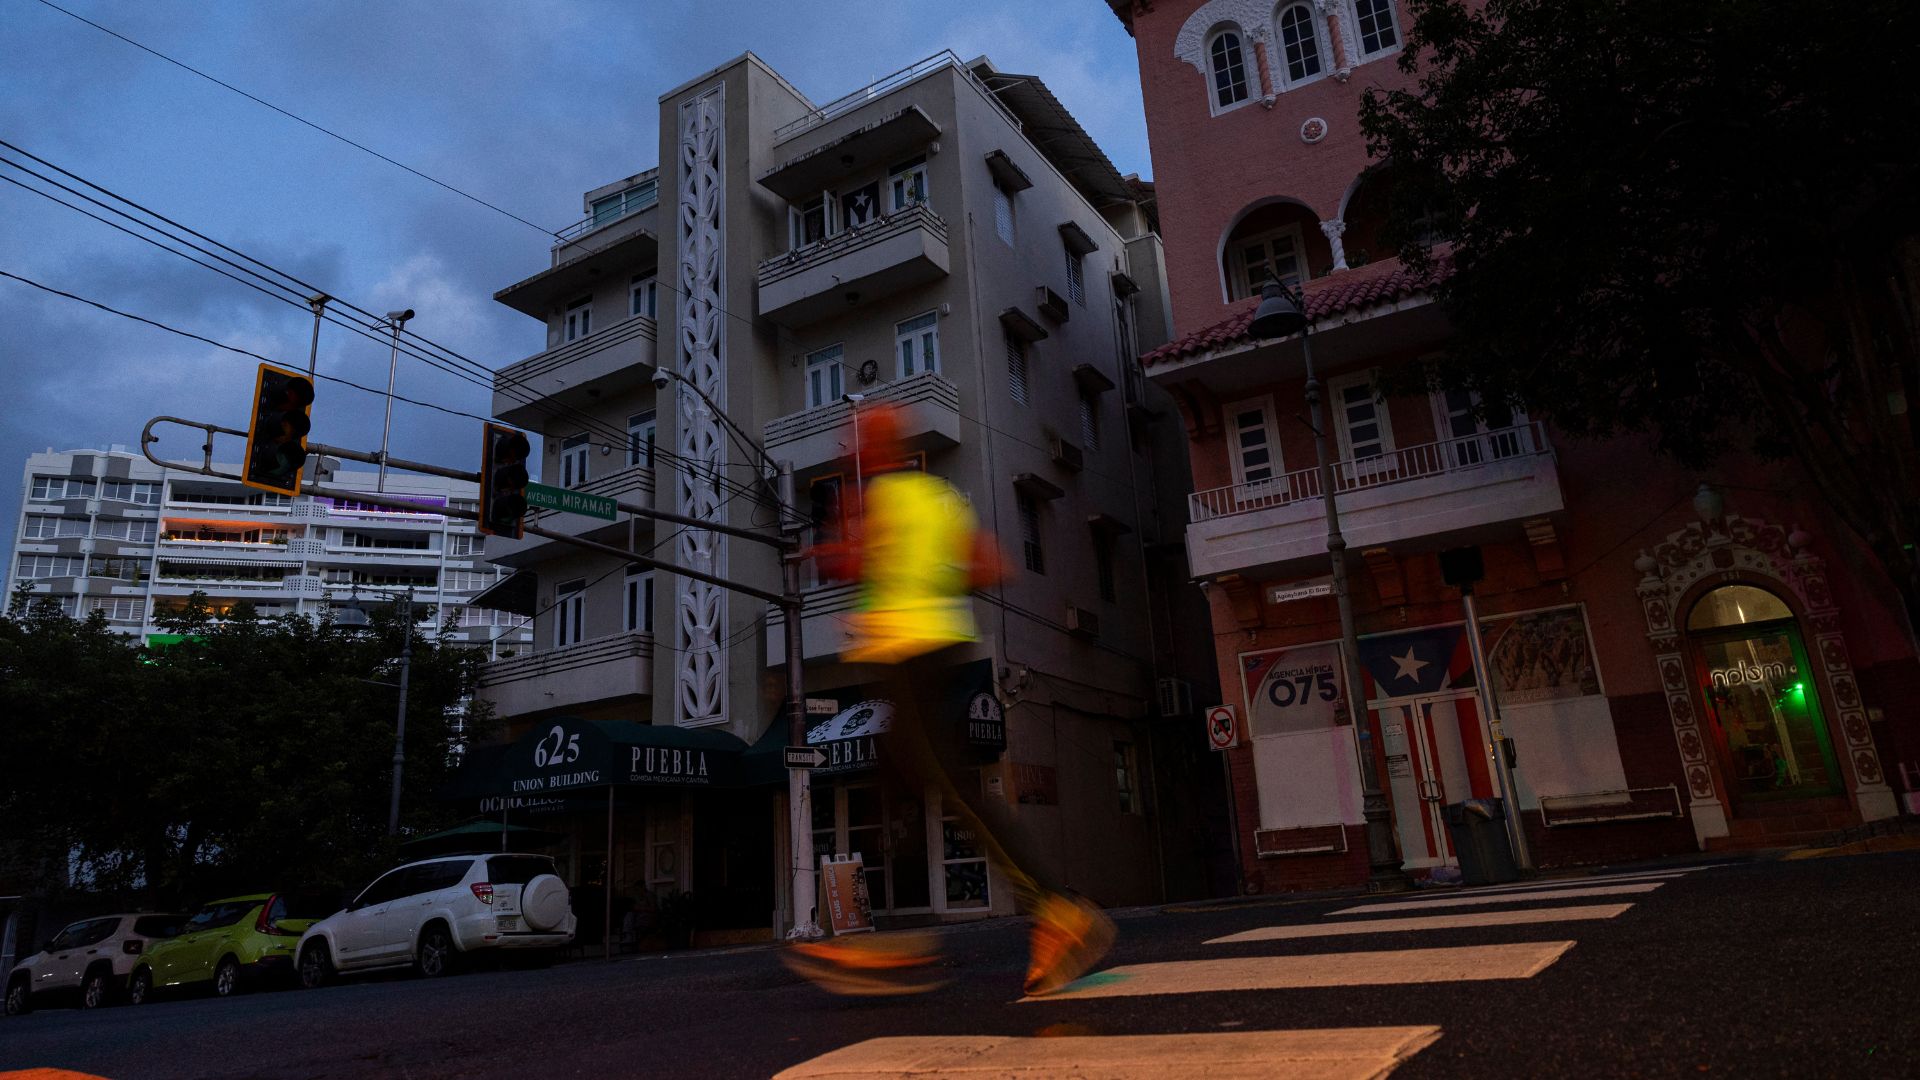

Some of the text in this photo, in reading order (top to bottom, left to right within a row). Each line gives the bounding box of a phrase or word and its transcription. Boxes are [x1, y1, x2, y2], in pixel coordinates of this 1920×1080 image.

[527, 491, 612, 516] AVENIDA MIRAMAR
[1269, 669, 1304, 680] AGENCIA
[1269, 672, 1337, 707] 075
[969, 721, 1002, 740] PUEBLA
[534, 725, 580, 768] 625
[821, 737, 878, 765] EBLA
[631, 746, 708, 775] PUEBLA
[513, 770, 599, 792] UNION BUILDING
